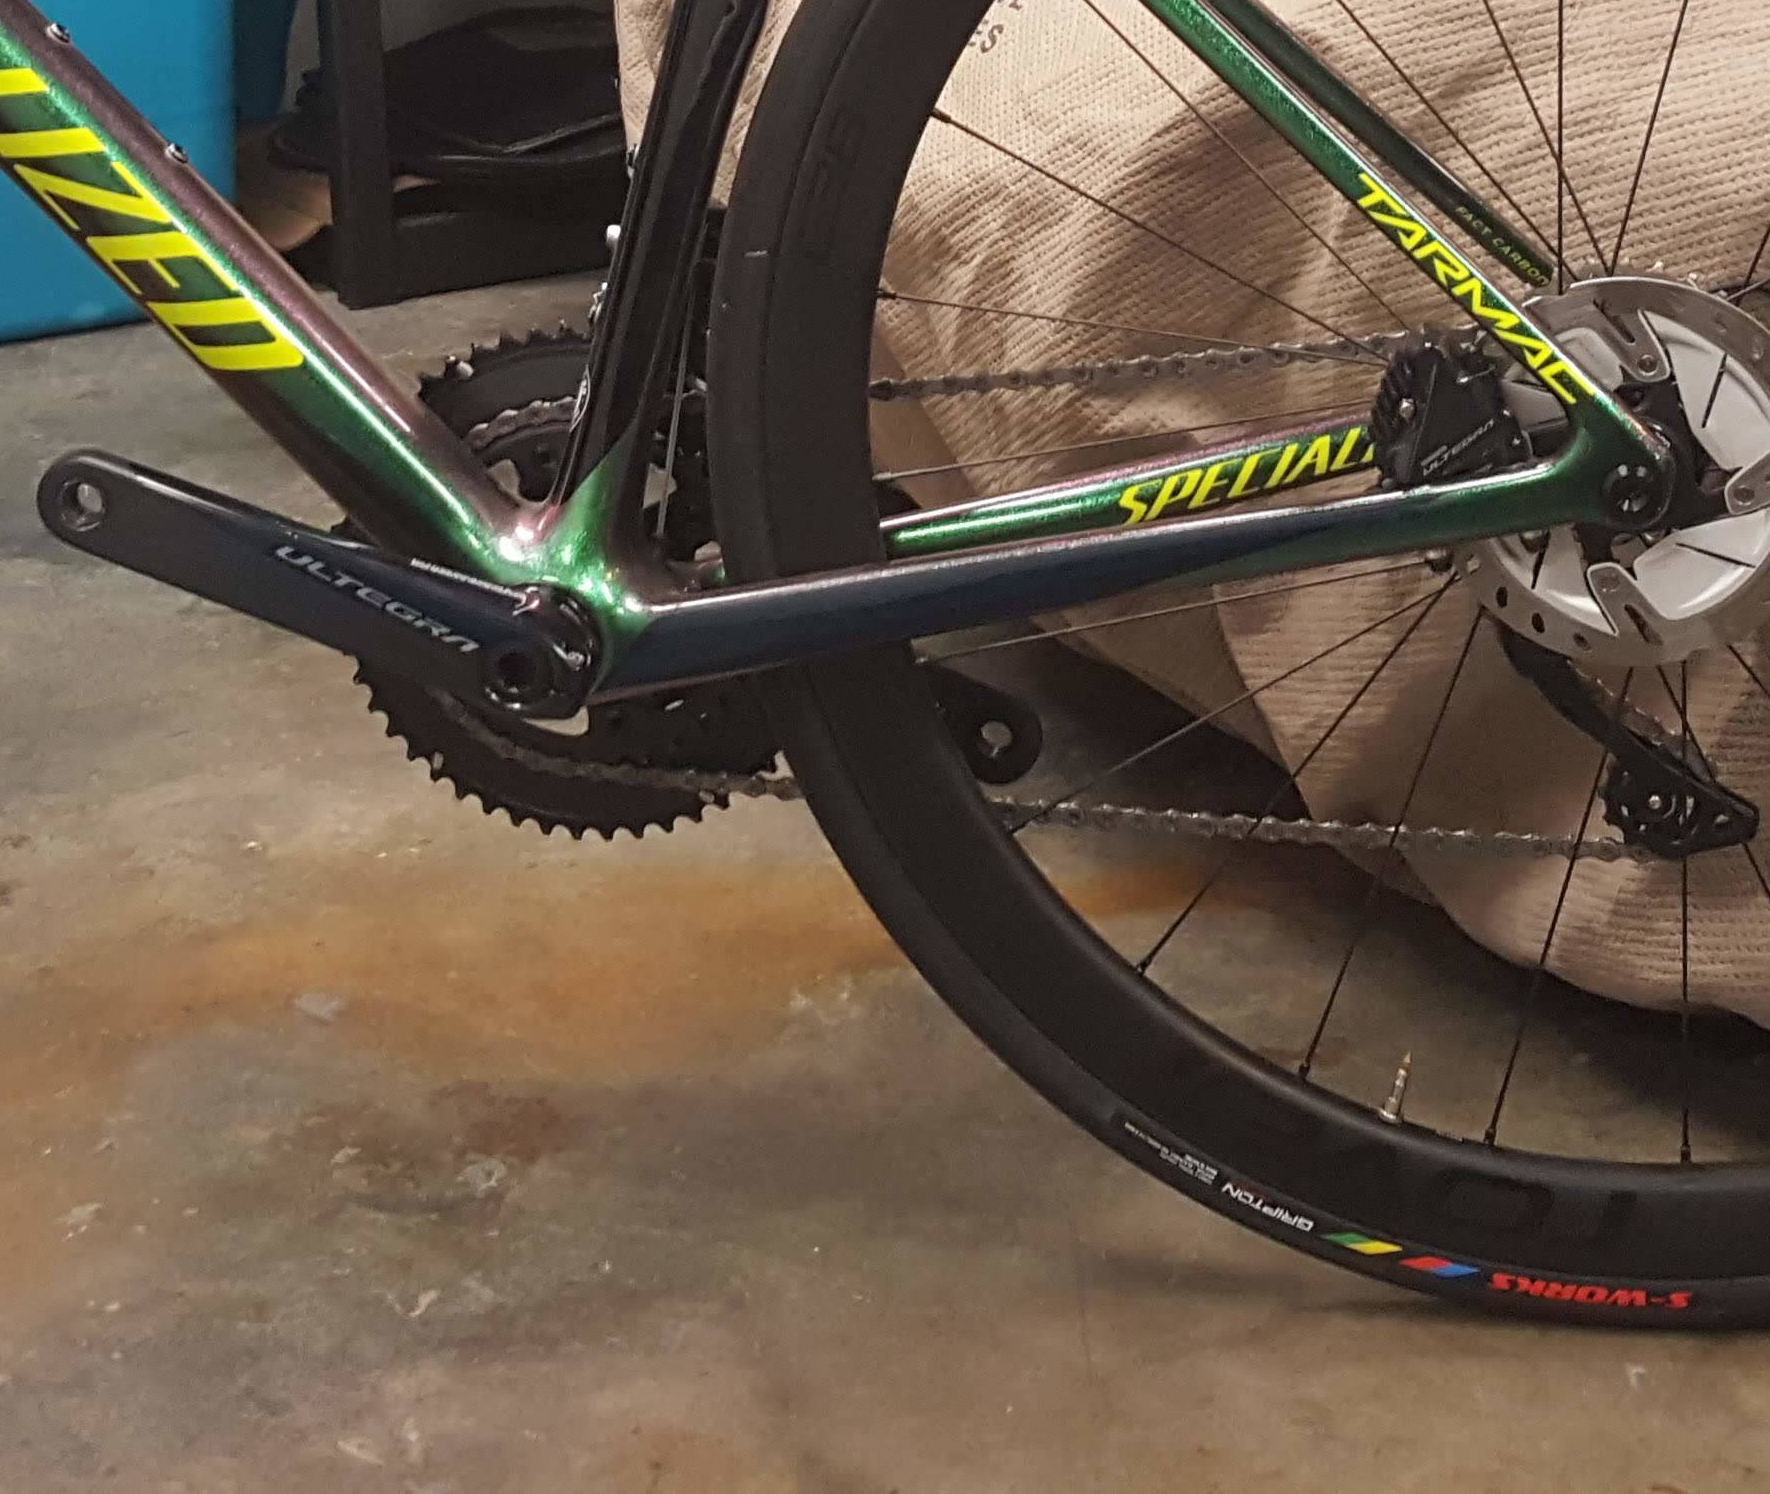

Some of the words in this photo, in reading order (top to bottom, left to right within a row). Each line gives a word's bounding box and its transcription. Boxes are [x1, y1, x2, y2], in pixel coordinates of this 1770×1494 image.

[1356, 171, 1596, 405] TARMAC
[275, 545, 480, 654] ULTEGRA
[1221, 1182, 1315, 1233] GRIPTON
[1489, 1272, 1694, 1308] S-WORKS
